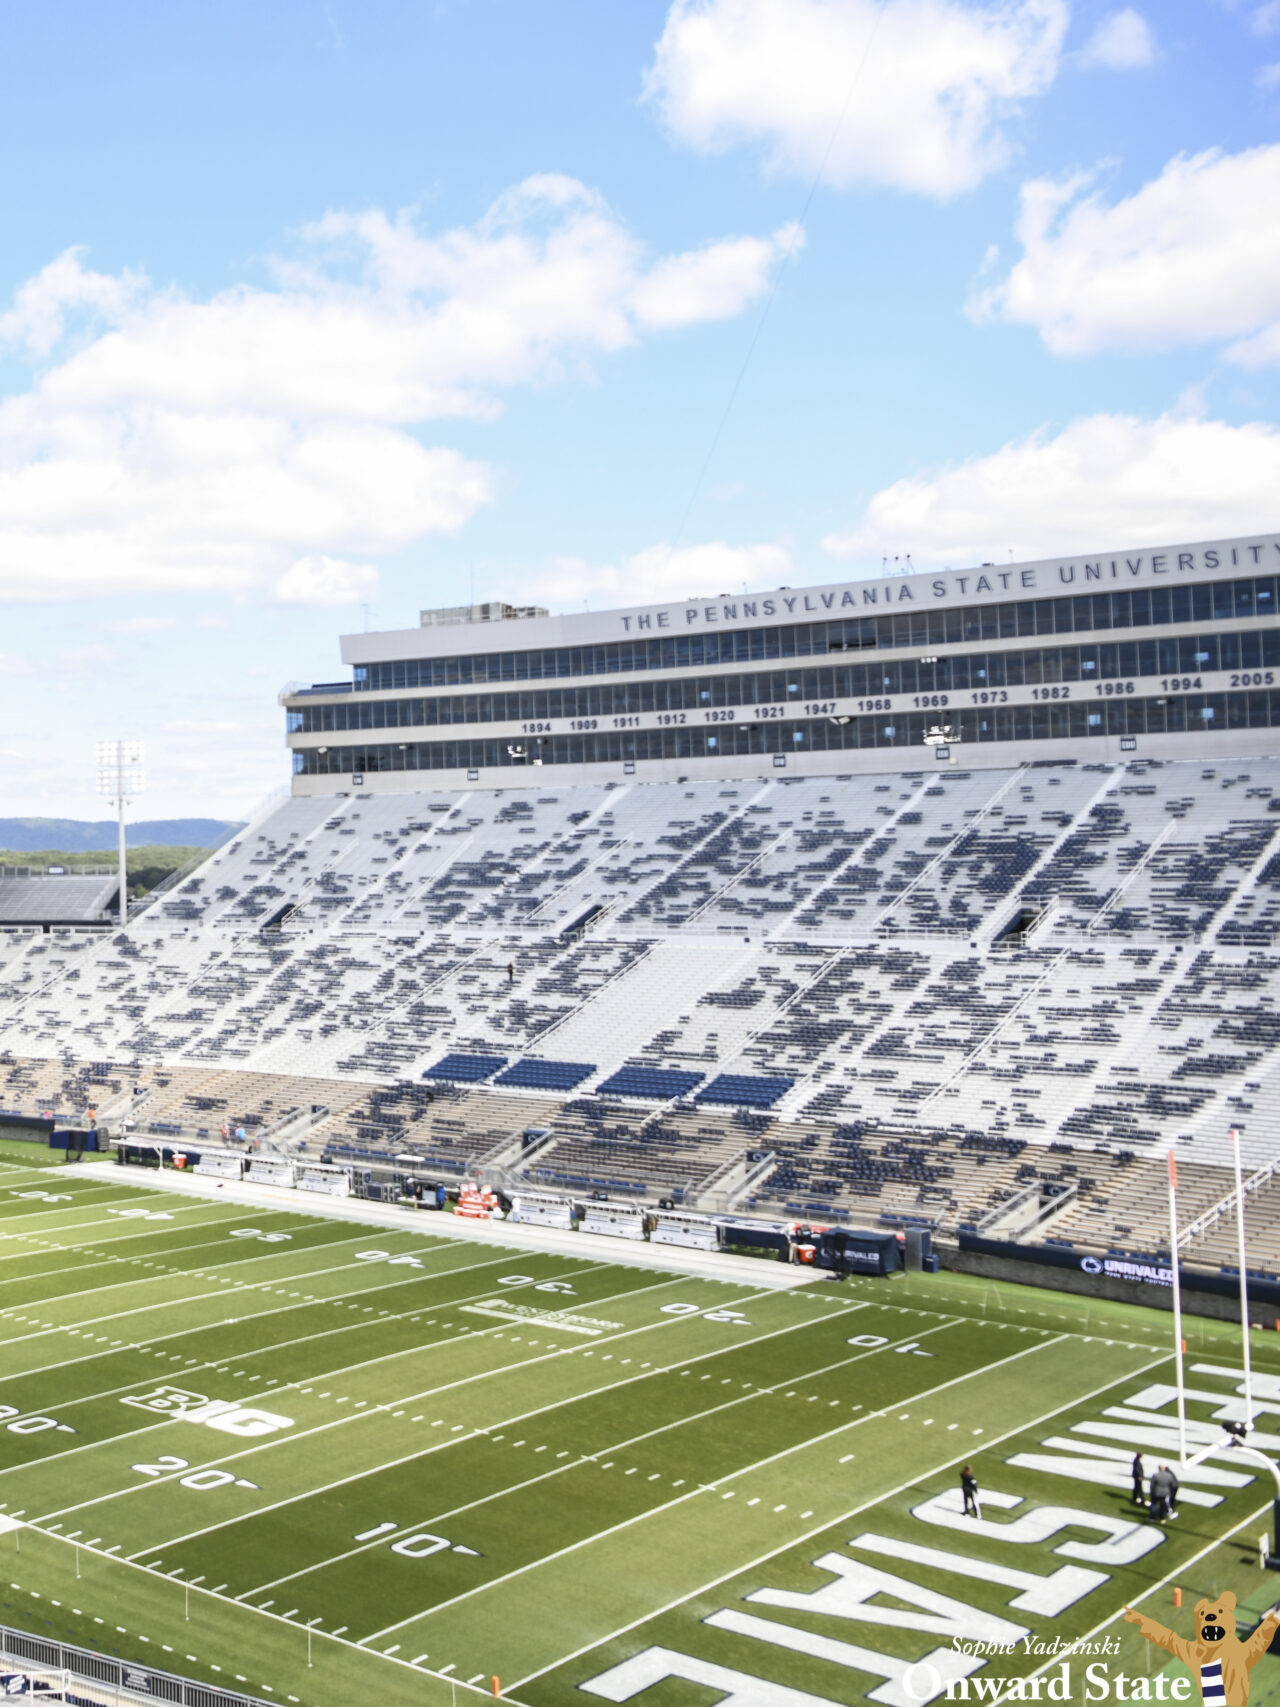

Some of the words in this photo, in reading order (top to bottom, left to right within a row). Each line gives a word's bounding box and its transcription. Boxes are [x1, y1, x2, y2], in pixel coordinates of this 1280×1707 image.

[621, 611, 669, 632] THE
[686, 584, 914, 625] PENNSYLVANIA
[932, 570, 1037, 597] STATE
[522, 722, 551, 734] 1894
[569, 719, 598, 731] 1909
[613, 716, 640, 728] 1911
[657, 713, 687, 726] 1912
[704, 710, 735, 723] 1920
[754, 706, 785, 719] 1921
[804, 702, 837, 715] 1947
[857, 699, 892, 712] 1968
[913, 695, 949, 708] 1969
[971, 691, 1009, 704] 1973
[1032, 686, 1070, 700] 1982
[1095, 682, 1135, 696] 1986
[1161, 677, 1202, 692] 1994
[1229, 672, 1275, 688] 2005
[130, 1455, 236, 1490] 20
[353, 1522, 452, 1558] 10
